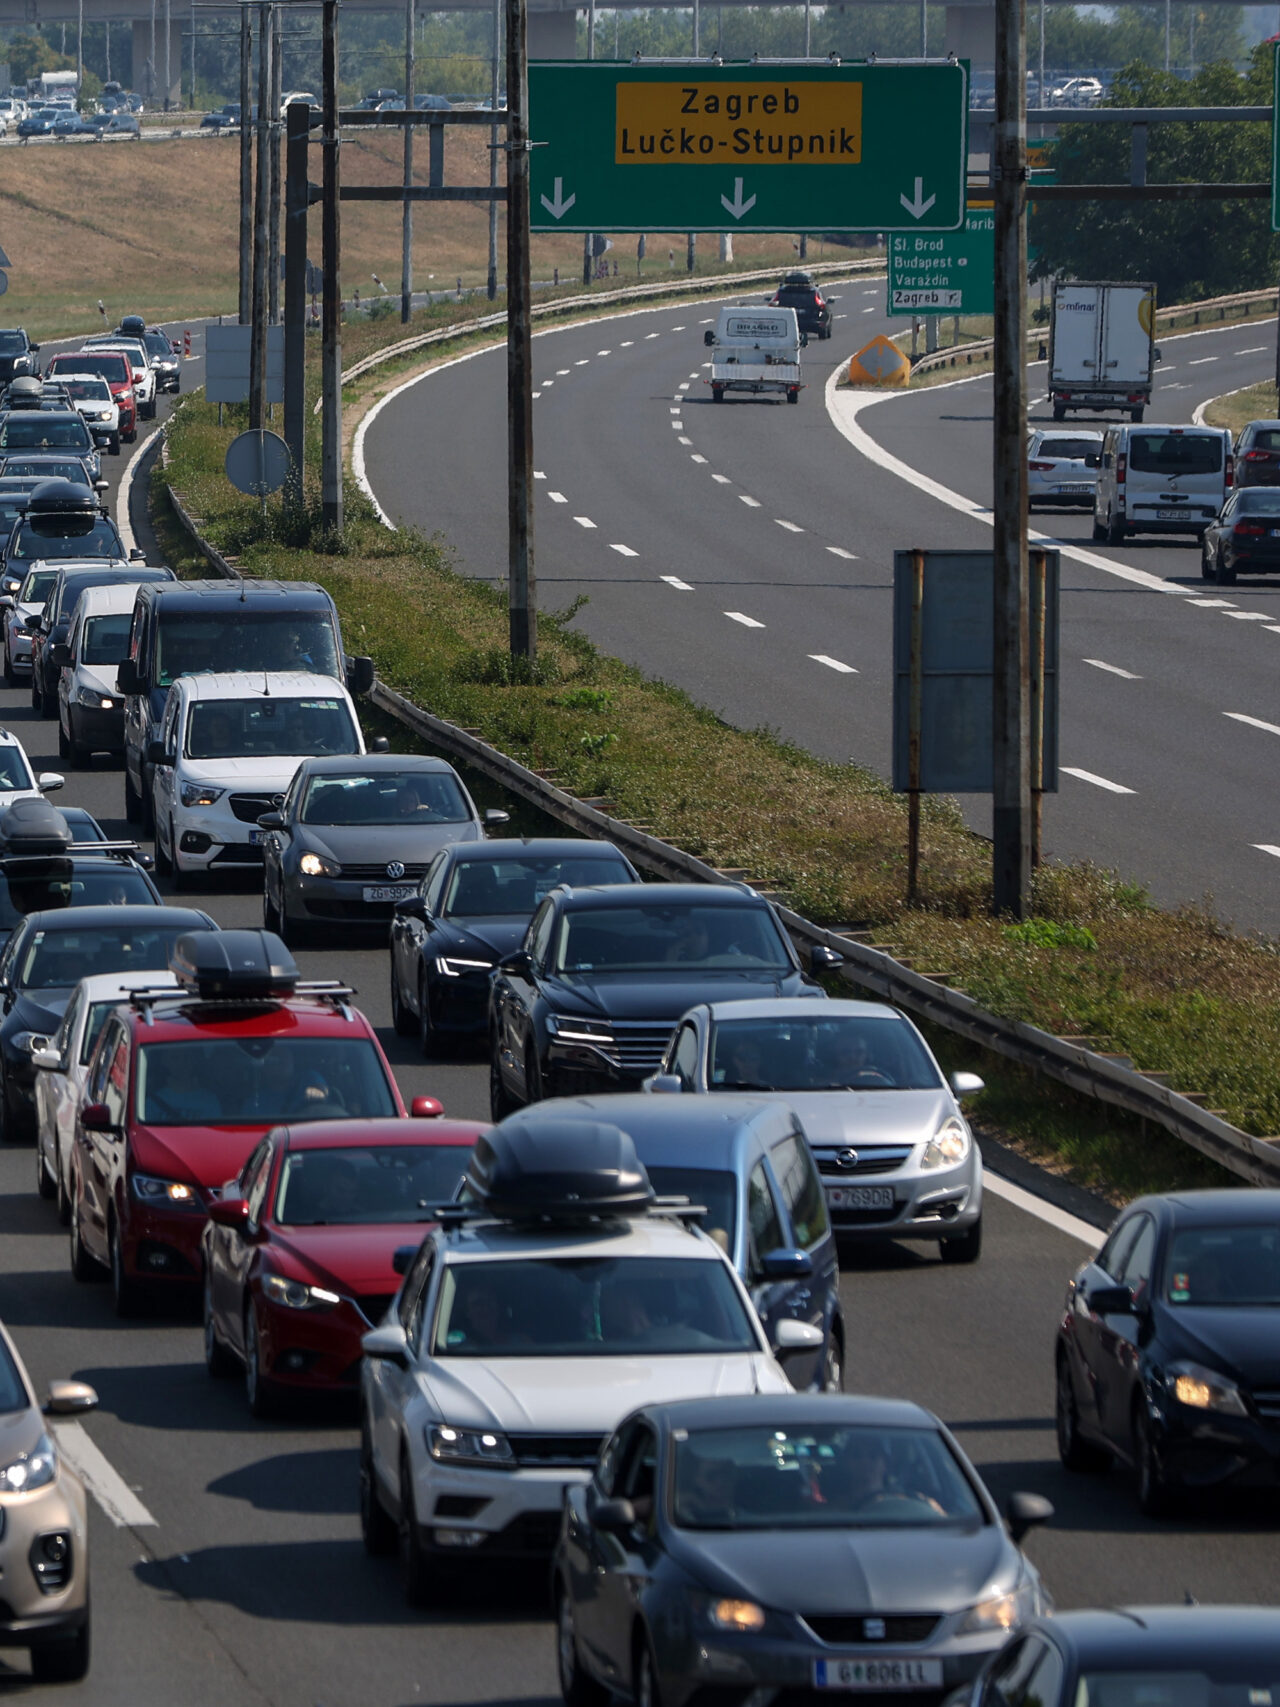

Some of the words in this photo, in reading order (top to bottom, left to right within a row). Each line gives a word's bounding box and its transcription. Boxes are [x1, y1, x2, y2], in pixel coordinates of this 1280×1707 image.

[681, 88, 800, 120] Zagreb
[622, 128, 856, 160] Lučko-Stupnik
[965, 217, 995, 230] arib
[894, 238, 910, 251] Sl.
[915, 238, 943, 251] Brod
[894, 256, 952, 270] Budapest
[895, 273, 949, 286] Varaždin
[894, 291, 939, 307] Zagreb
[371, 887, 384, 899] ZG
